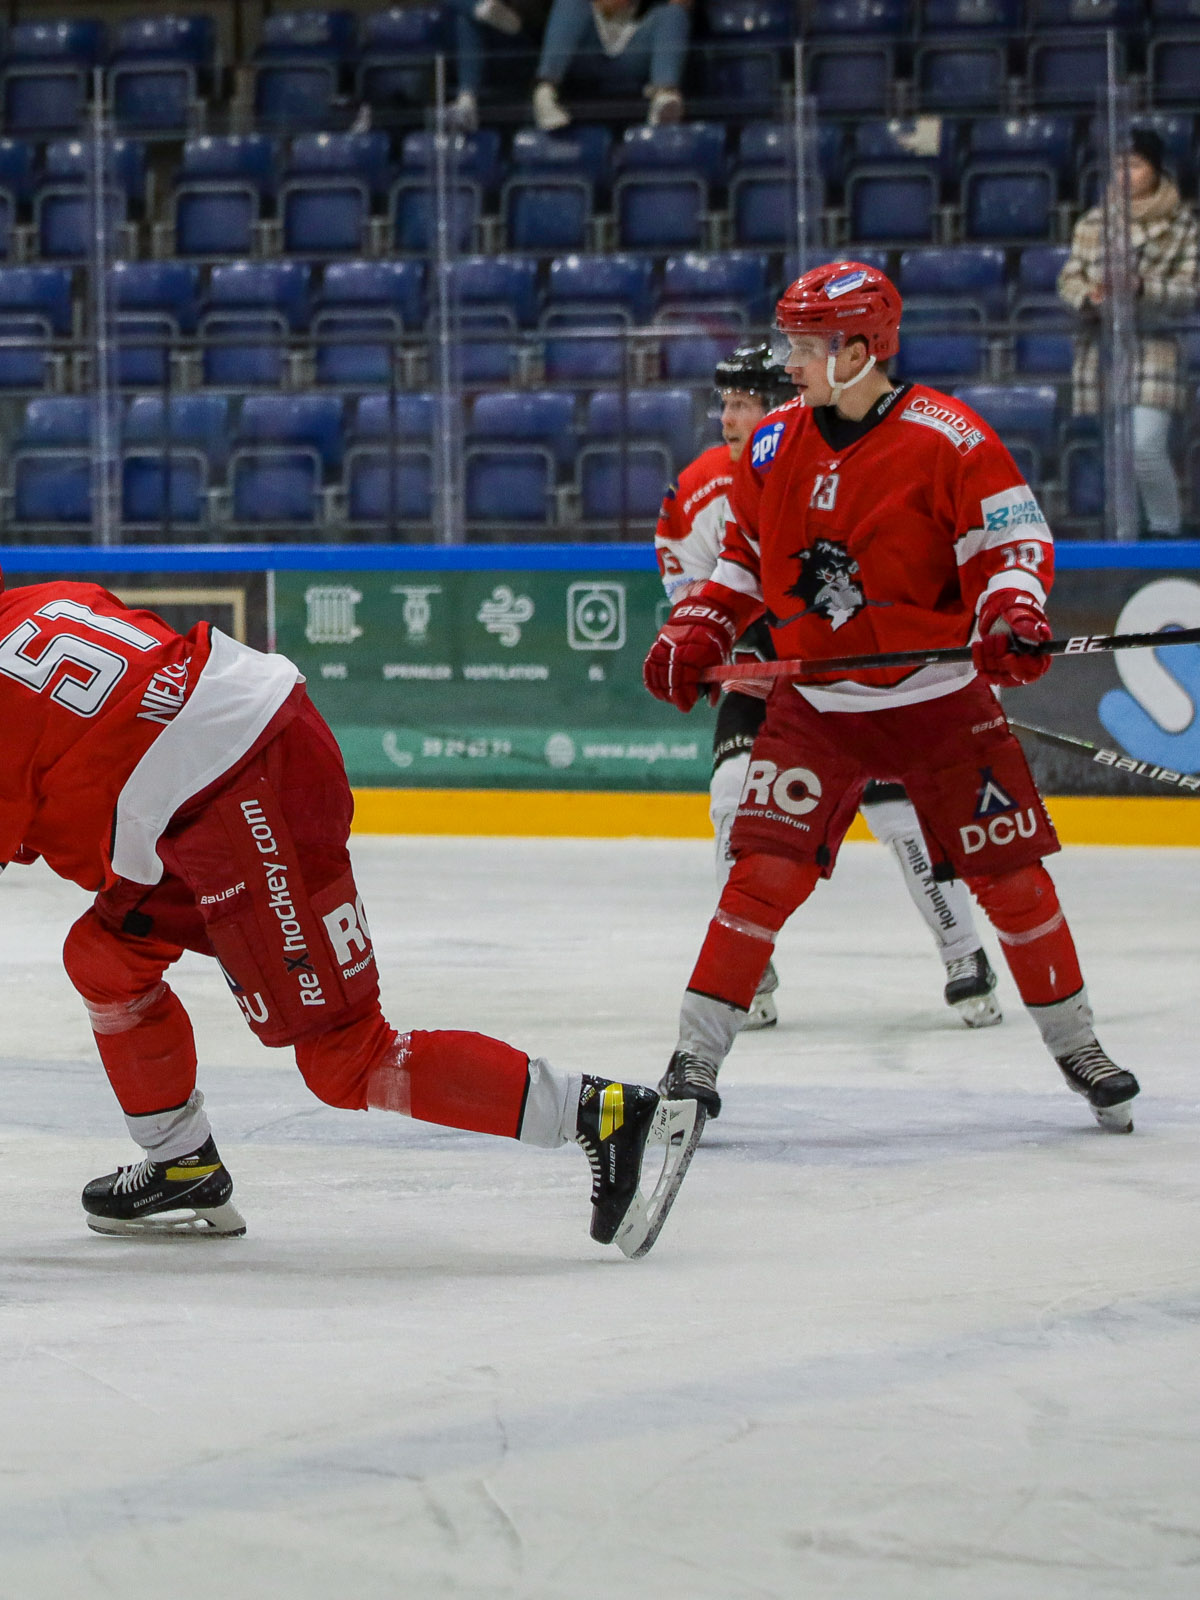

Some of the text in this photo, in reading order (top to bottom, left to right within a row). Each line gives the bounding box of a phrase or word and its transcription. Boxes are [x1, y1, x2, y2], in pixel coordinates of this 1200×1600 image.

[877, 385, 905, 416] BAUE
[910, 398, 976, 437] Combi
[809, 473, 840, 511] 13
[739, 760, 822, 815] RC
[1093, 748, 1200, 792] BAUER
[765, 810, 811, 833] Centrum
[959, 808, 1037, 855] DCU
[200, 881, 246, 905] BAUER
[609, 1143, 617, 1184] BAUER
[133, 1191, 163, 1209] BAUER
